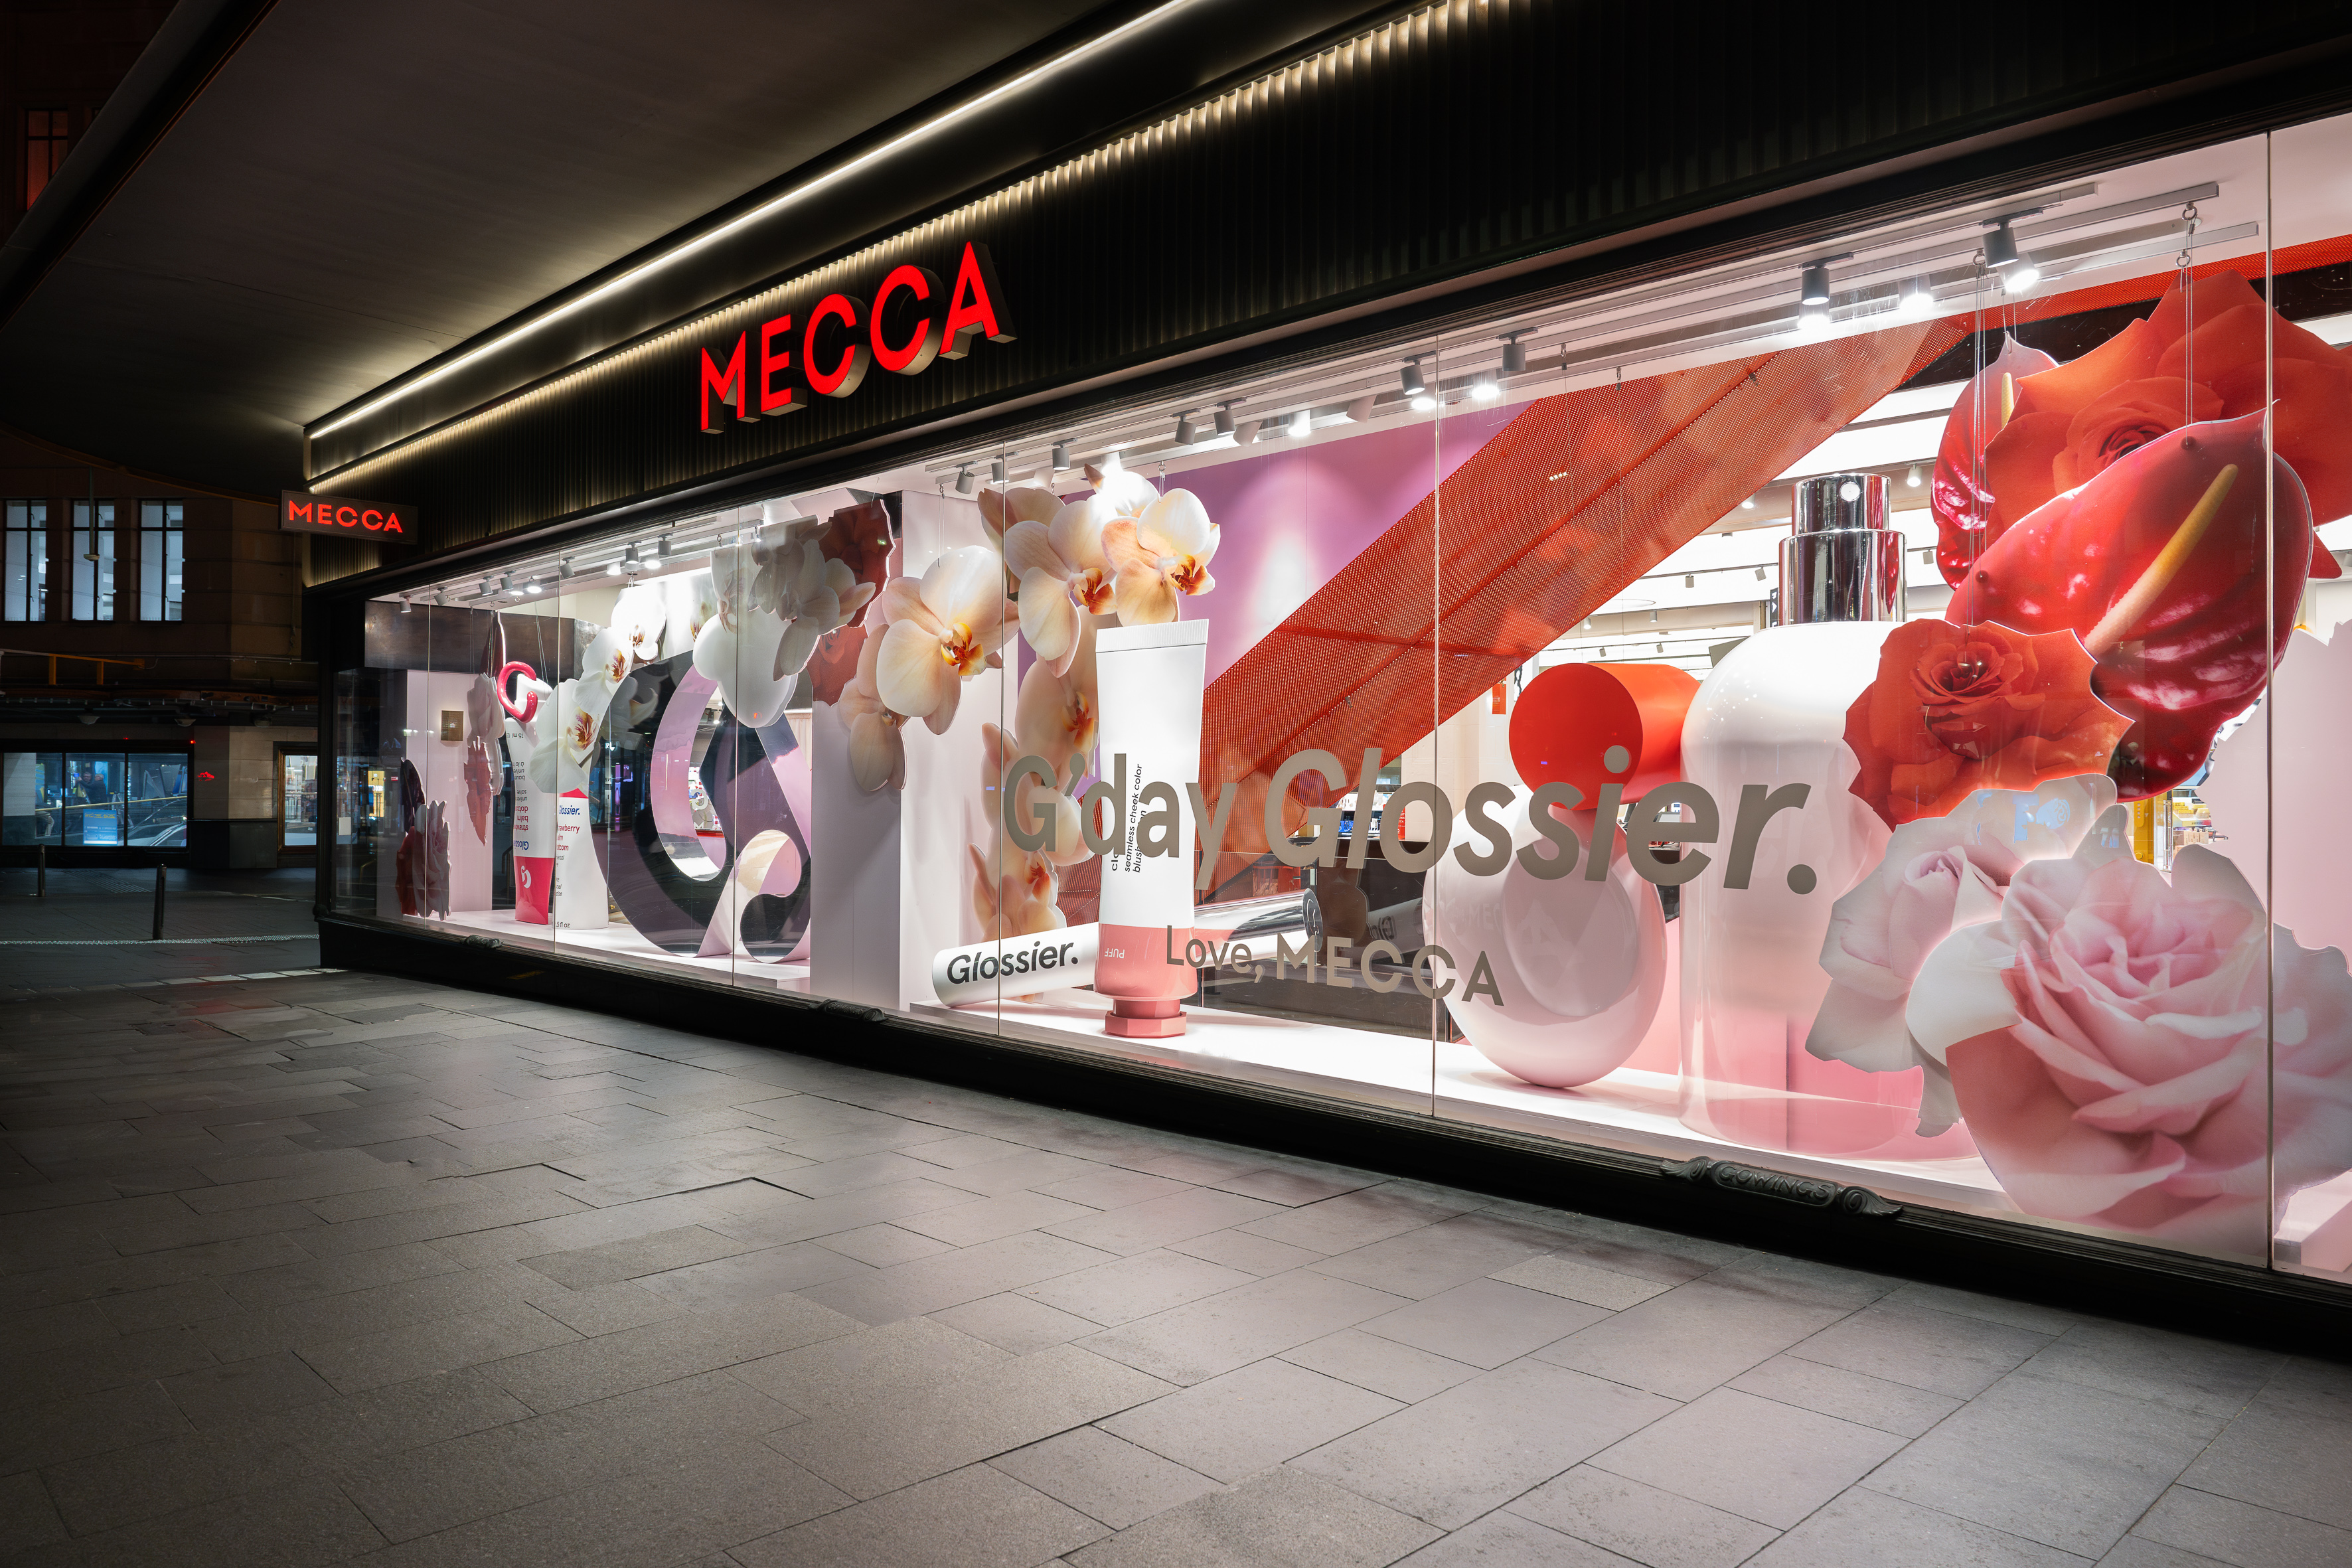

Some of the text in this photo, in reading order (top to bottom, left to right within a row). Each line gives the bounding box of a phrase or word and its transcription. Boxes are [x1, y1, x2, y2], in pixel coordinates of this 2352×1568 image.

[701, 241, 1004, 433] MECCA
[289, 500, 403, 533] MECCA
[1004, 744, 1818, 895] G'day Glossier.
[1125, 763, 1142, 872] seamless cheek color
[947, 941, 1079, 984] Glossier.
[1104, 947, 1125, 959] PUFF
[1166, 925, 1504, 1006] Love, MECCA
[1719, 1165, 1831, 1200] GOWINGS
